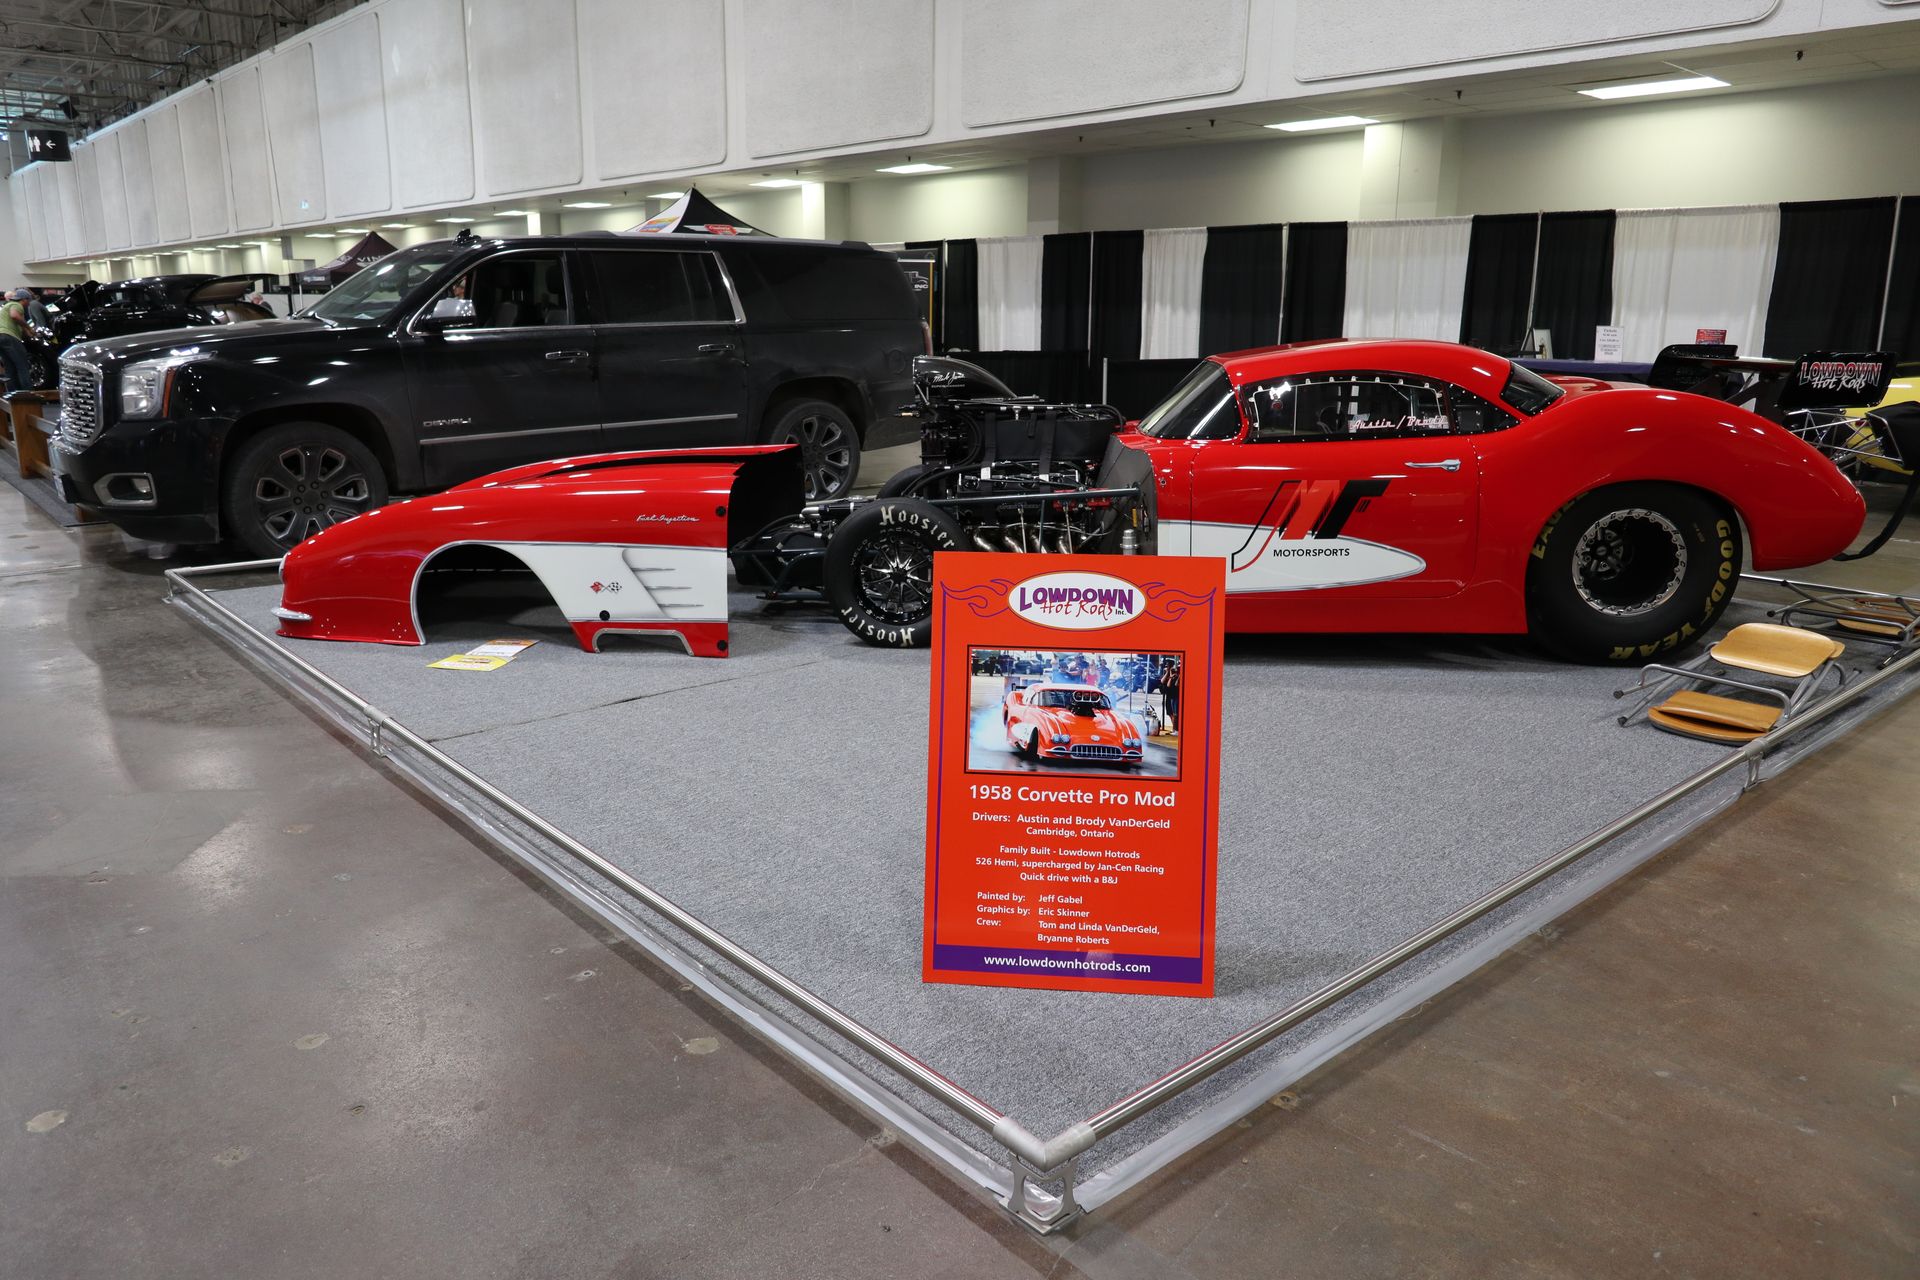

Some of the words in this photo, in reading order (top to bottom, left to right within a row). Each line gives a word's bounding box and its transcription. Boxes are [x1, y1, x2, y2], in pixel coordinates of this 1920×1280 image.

[1800, 361, 1882, 387] LOWDOWN
[1812, 375, 1836, 389] Hot
[1836, 377, 1866, 393] Rods
[1350, 418, 1396, 430] Austin
[880, 505, 955, 549] Hoosier
[1273, 548, 1350, 558] MOTORSPORTS
[1019, 587, 1134, 615] LOWDOWN
[1040, 599, 1072, 614] Hot
[1075, 599, 1113, 620] Rods
[841, 606, 916, 647] Hoosier
[969, 785, 1012, 800] 1958
[1018, 787, 1093, 804] Corvette
[1099, 790, 1128, 805] Pro
[1135, 791, 1175, 807] Mod
[972, 812, 1011, 822] Drivers:
[1017, 814, 1049, 824] Austin
[1052, 815, 1072, 825] and
[1075, 816, 1105, 827] Brody
[1109, 818, 1170, 829] VanDerGeld
[1026, 827, 1078, 838] Cambridge,
[1080, 829, 1114, 838] Ontario
[1000, 845, 1028, 856] Family
[1030, 846, 1050, 855] Built
[1058, 848, 1102, 857] Lowdown
[1104, 850, 1140, 859] Hotrods
[994, 858, 1019, 868] Hemi,
[1021, 860, 1081, 871] supercharged
[1084, 862, 1095, 872] by
[1097, 863, 1132, 872] Jan-Cen
[1134, 865, 1164, 875] Racing
[1020, 872, 1044, 882] Quick
[1047, 873, 1069, 882] drive
[1071, 875, 1091, 883] with
[1102, 876, 1118, 885] B&J
[977, 892, 1010, 901] Painted
[1012, 893, 1026, 903] by:
[1038, 894, 1056, 903] Jeff
[1057, 895, 1083, 904] Gabel
[977, 905, 1015, 915] Graphics
[1017, 906, 1030, 915] by:
[1038, 907, 1055, 916] Eric
[1056, 908, 1090, 918] Skinner
[976, 918, 1001, 927] Crew:
[1038, 920, 1056, 929] Tom
[1059, 921, 1076, 930] and
[1078, 922, 1102, 931] Linda
[1105, 924, 1160, 935] VanDerGeld,
[1037, 934, 1073, 944] Bryanne
[1075, 936, 1110, 945] Roberts
[983, 955, 1151, 973] www.lowdownhotrods.com
